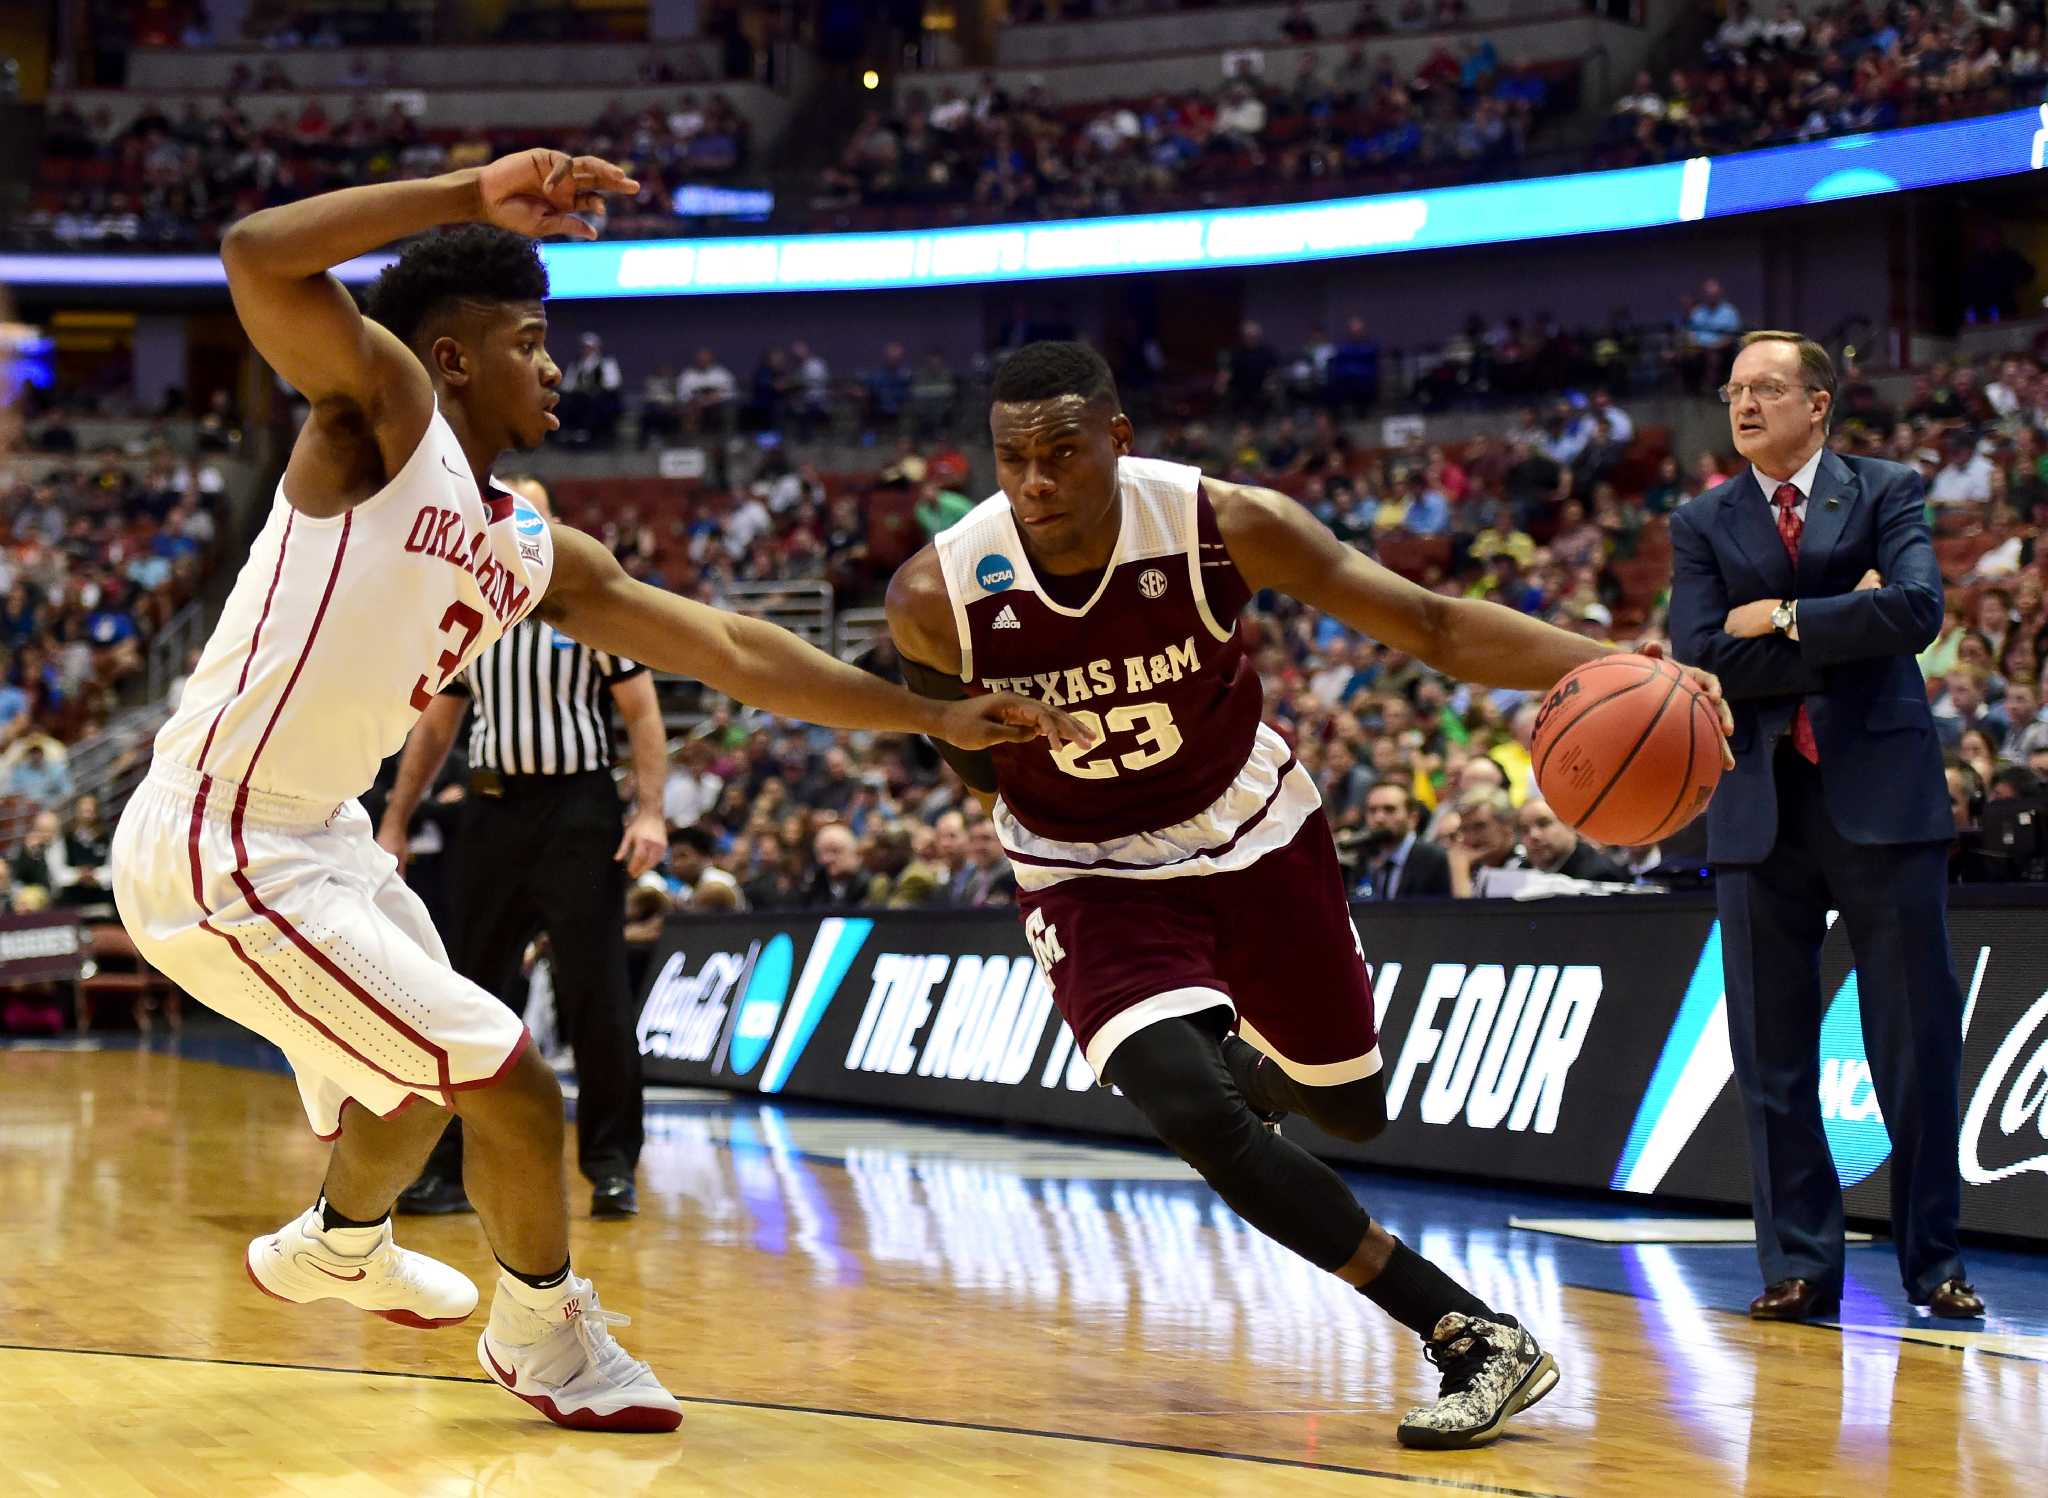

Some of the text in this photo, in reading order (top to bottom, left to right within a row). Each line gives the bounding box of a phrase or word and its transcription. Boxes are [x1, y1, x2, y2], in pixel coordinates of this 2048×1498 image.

[404, 505, 532, 631] OKLAHOM
[982, 569, 1013, 586] NCAA
[1140, 571, 1165, 597] SEC
[410, 600, 484, 712] 3
[992, 620, 1021, 629] adidas
[1124, 636, 1201, 693] A&M
[1049, 702, 1183, 779] 23
[1531, 679, 1579, 741] CAA
[844, 953, 951, 1074] THE
[917, 954, 1055, 1085] ROAD
[1386, 963, 1603, 1134] FOUR
